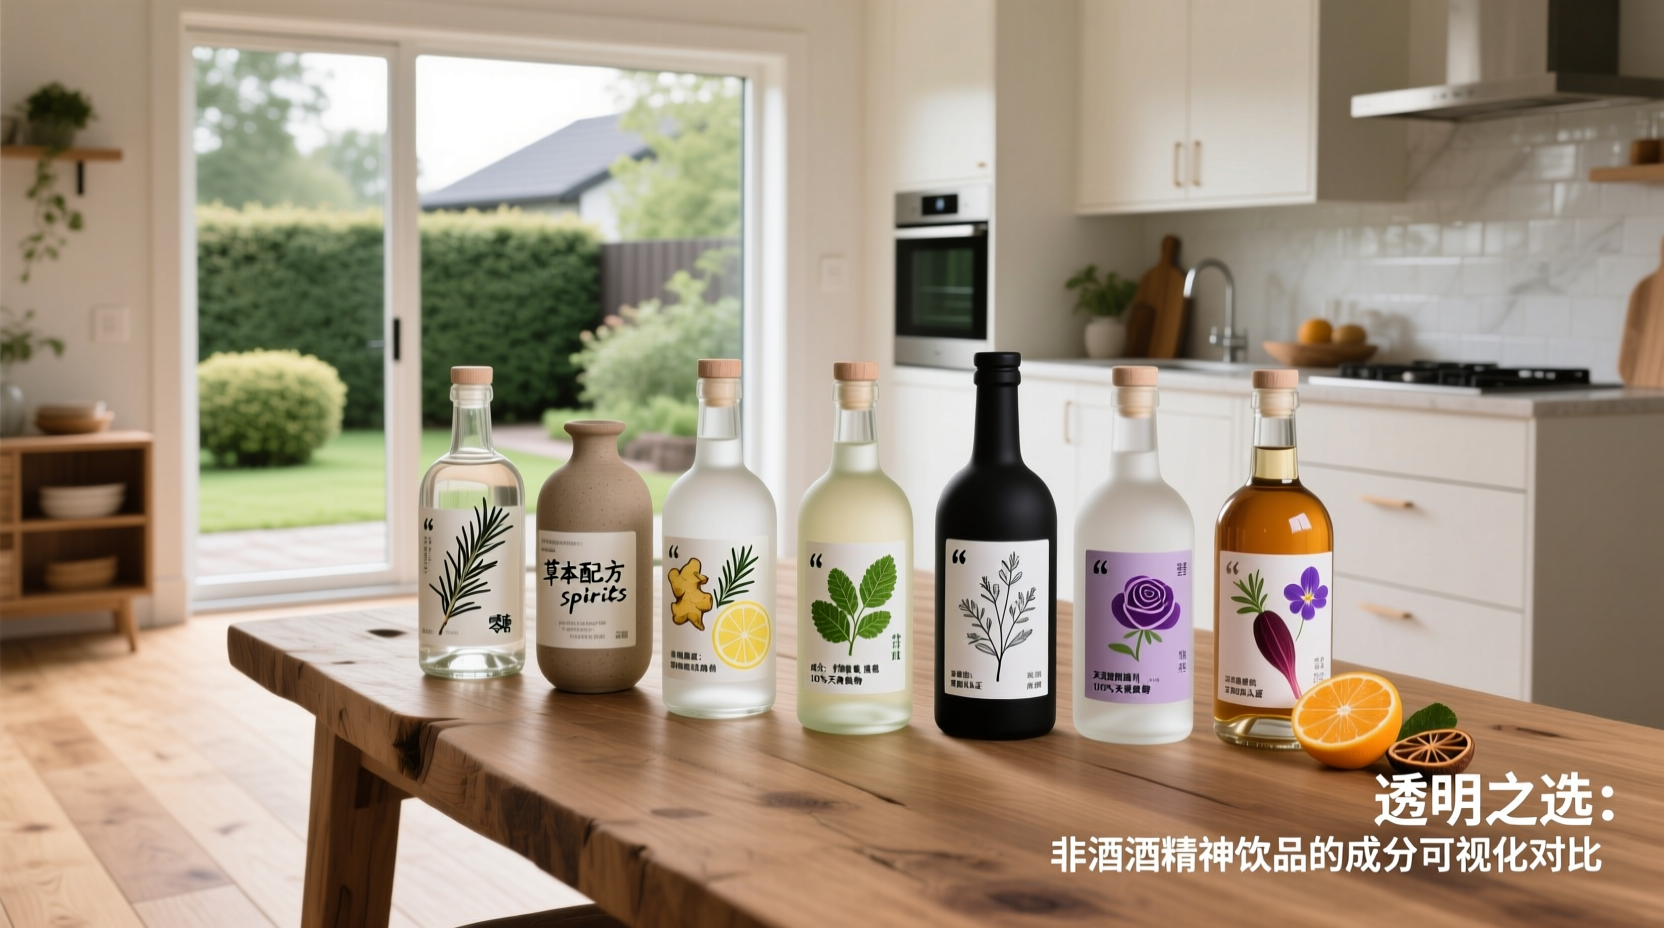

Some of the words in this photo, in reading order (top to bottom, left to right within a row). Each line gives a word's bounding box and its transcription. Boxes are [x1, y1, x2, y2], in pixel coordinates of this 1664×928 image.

[543, 558, 625, 586] 草本配方
[560, 585, 627, 614] spirits
